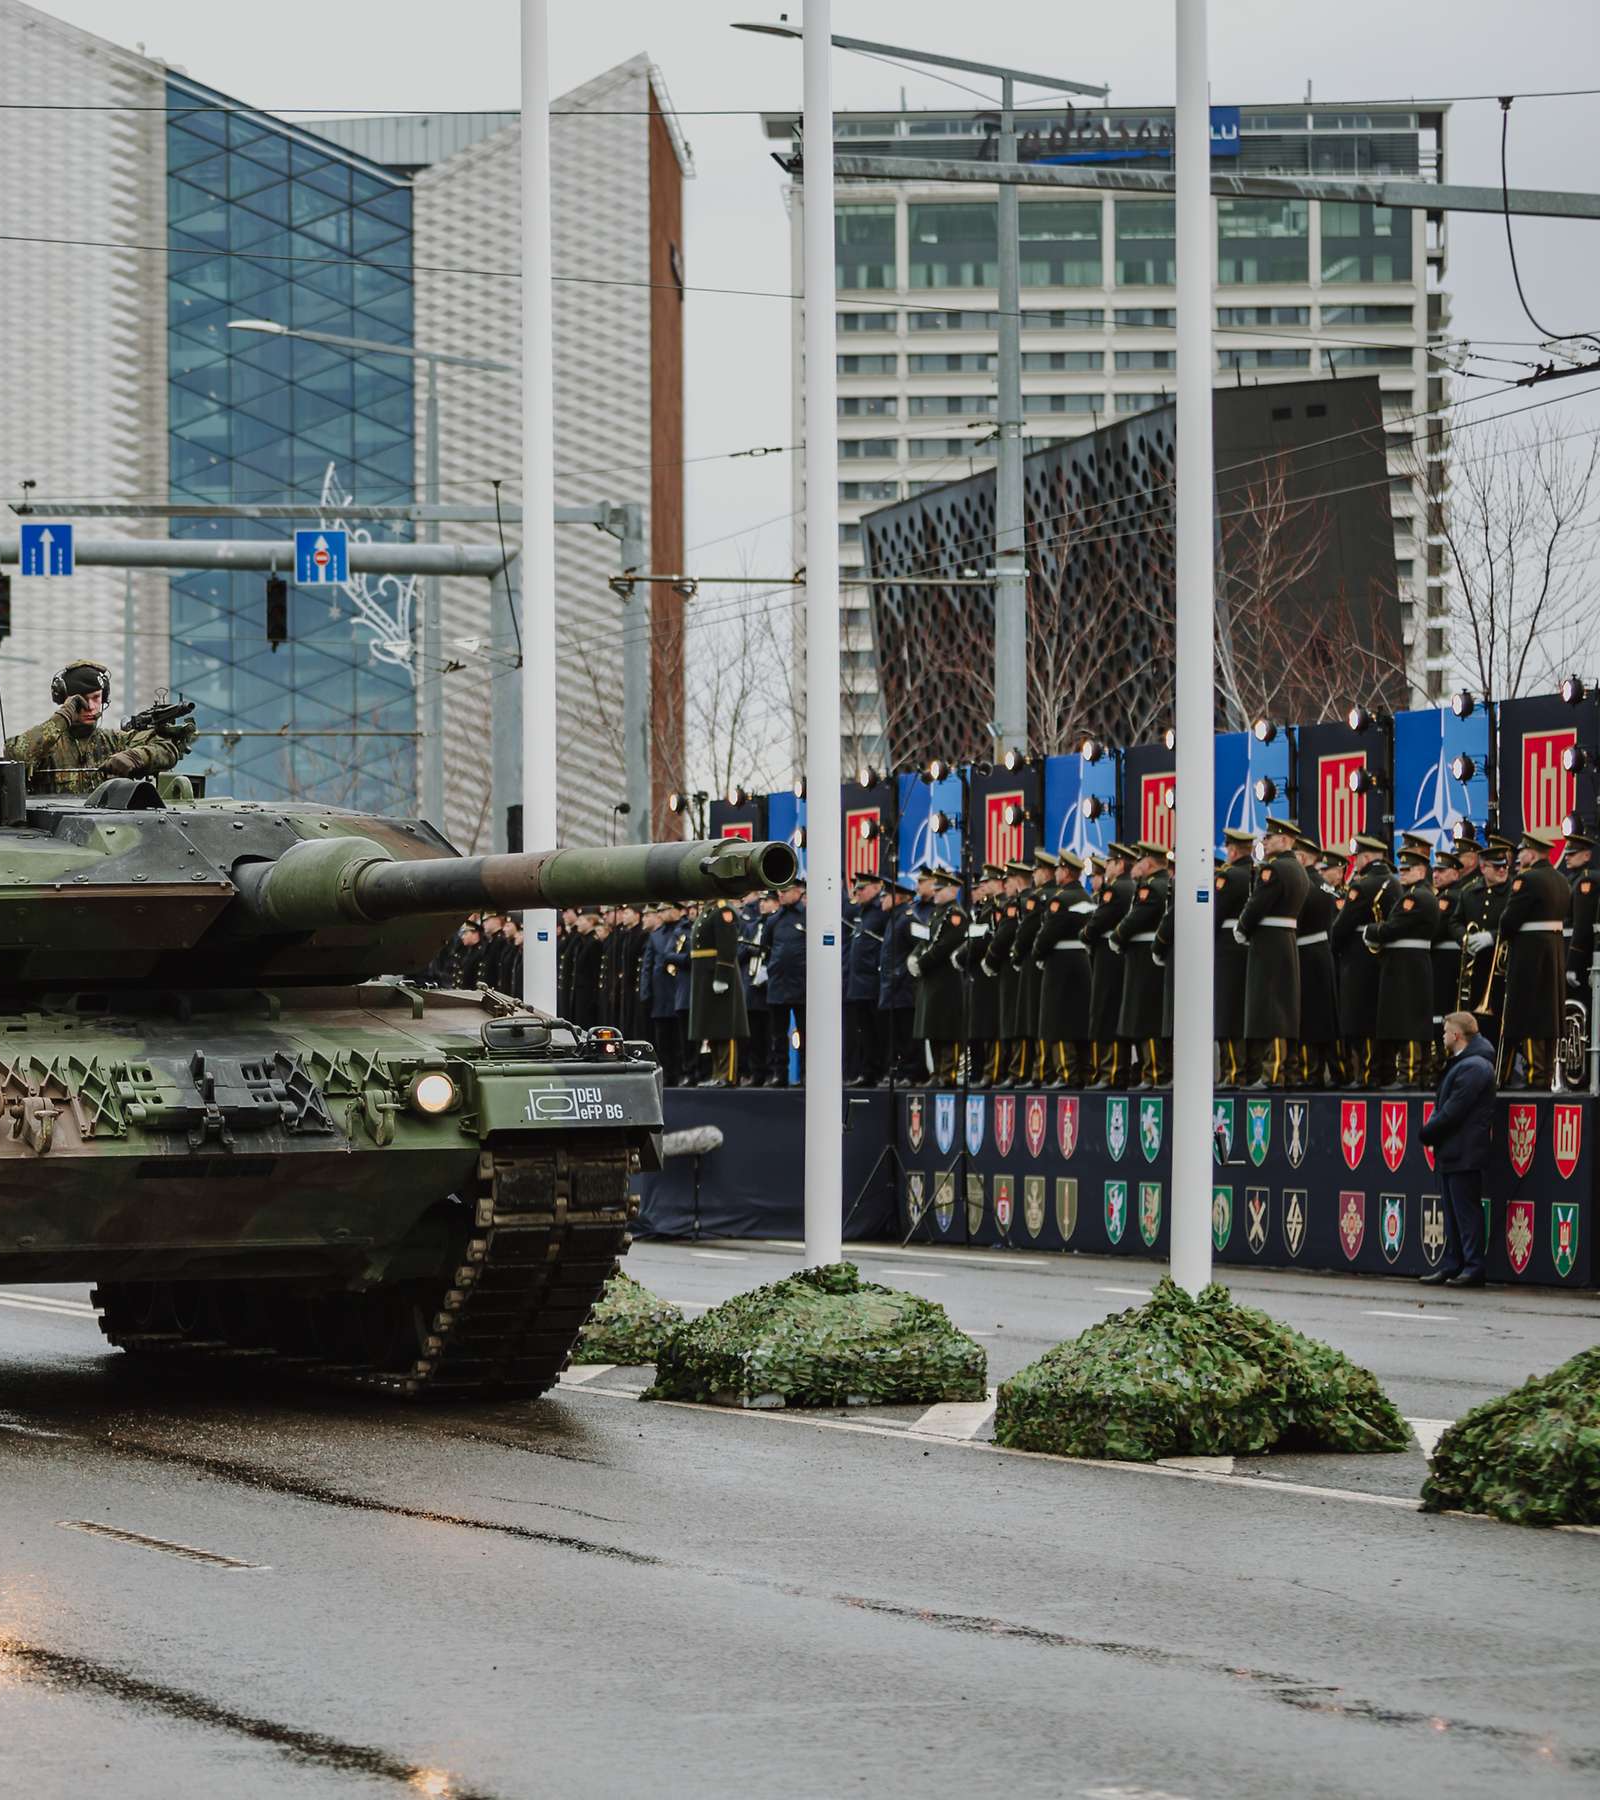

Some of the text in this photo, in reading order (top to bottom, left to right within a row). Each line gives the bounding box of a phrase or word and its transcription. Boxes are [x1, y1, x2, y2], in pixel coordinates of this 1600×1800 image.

[577, 1088, 602, 1103] DEU
[524, 1105, 532, 1121] 1
[580, 1103, 624, 1120] eFP BG
